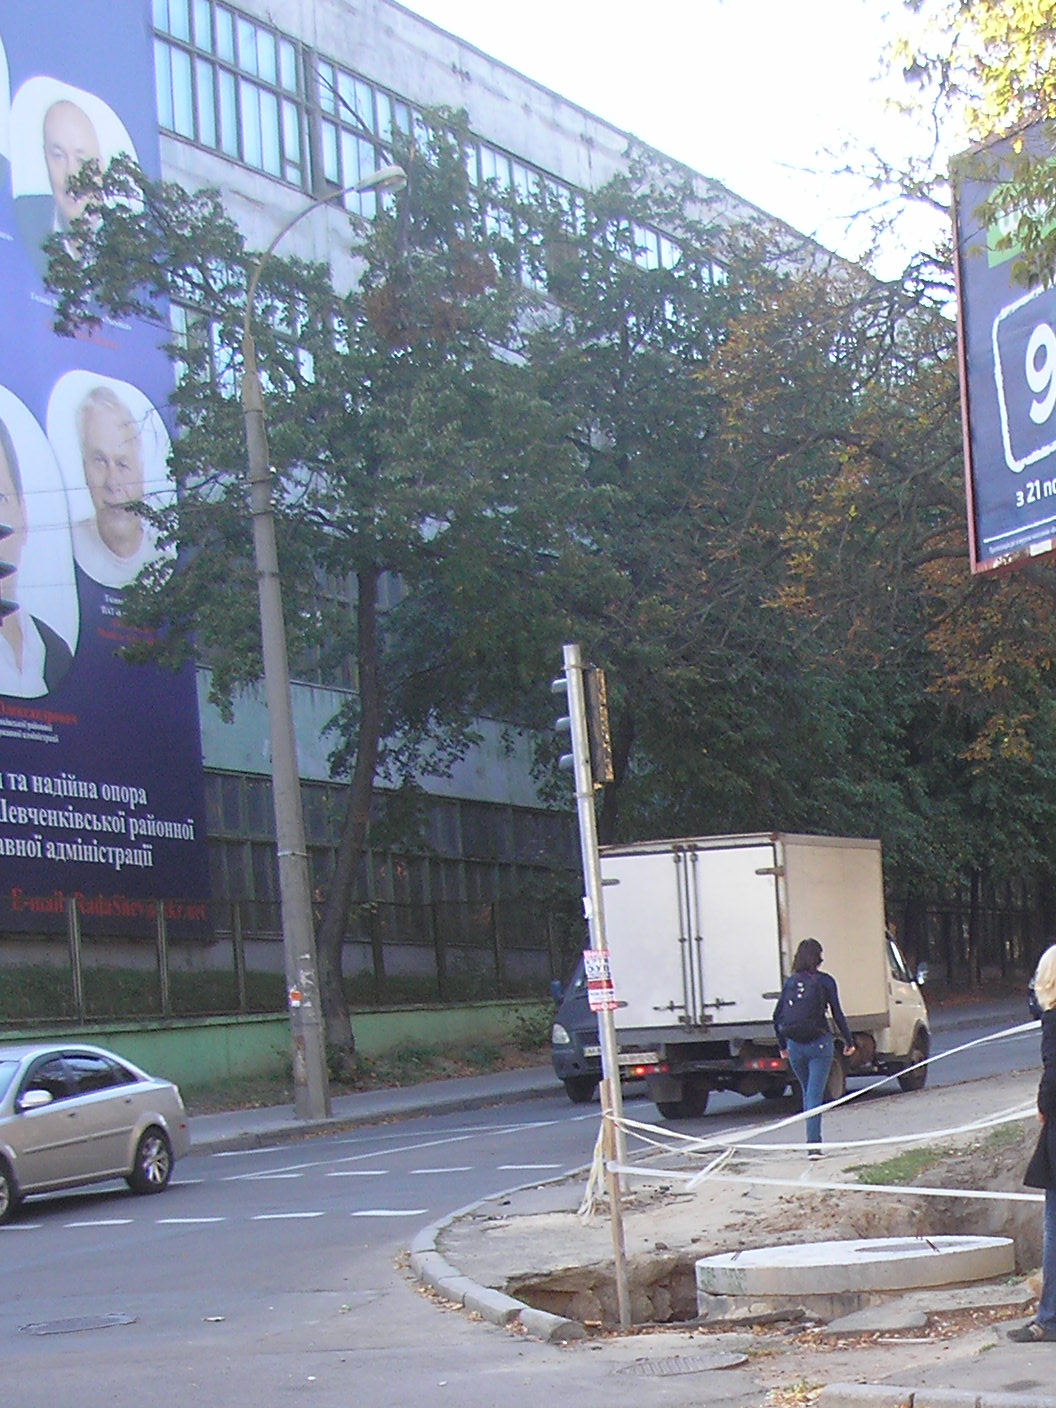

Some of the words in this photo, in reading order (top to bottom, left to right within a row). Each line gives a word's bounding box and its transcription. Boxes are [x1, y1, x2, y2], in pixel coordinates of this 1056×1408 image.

[1026, 480, 1041, 503] 21
[7, 773, 28, 792] та
[32, 772, 99, 799] надійна
[102, 784, 147, 809] опора
[129, 813, 195, 841] районної
[46, 838, 153, 871] адміністрації
